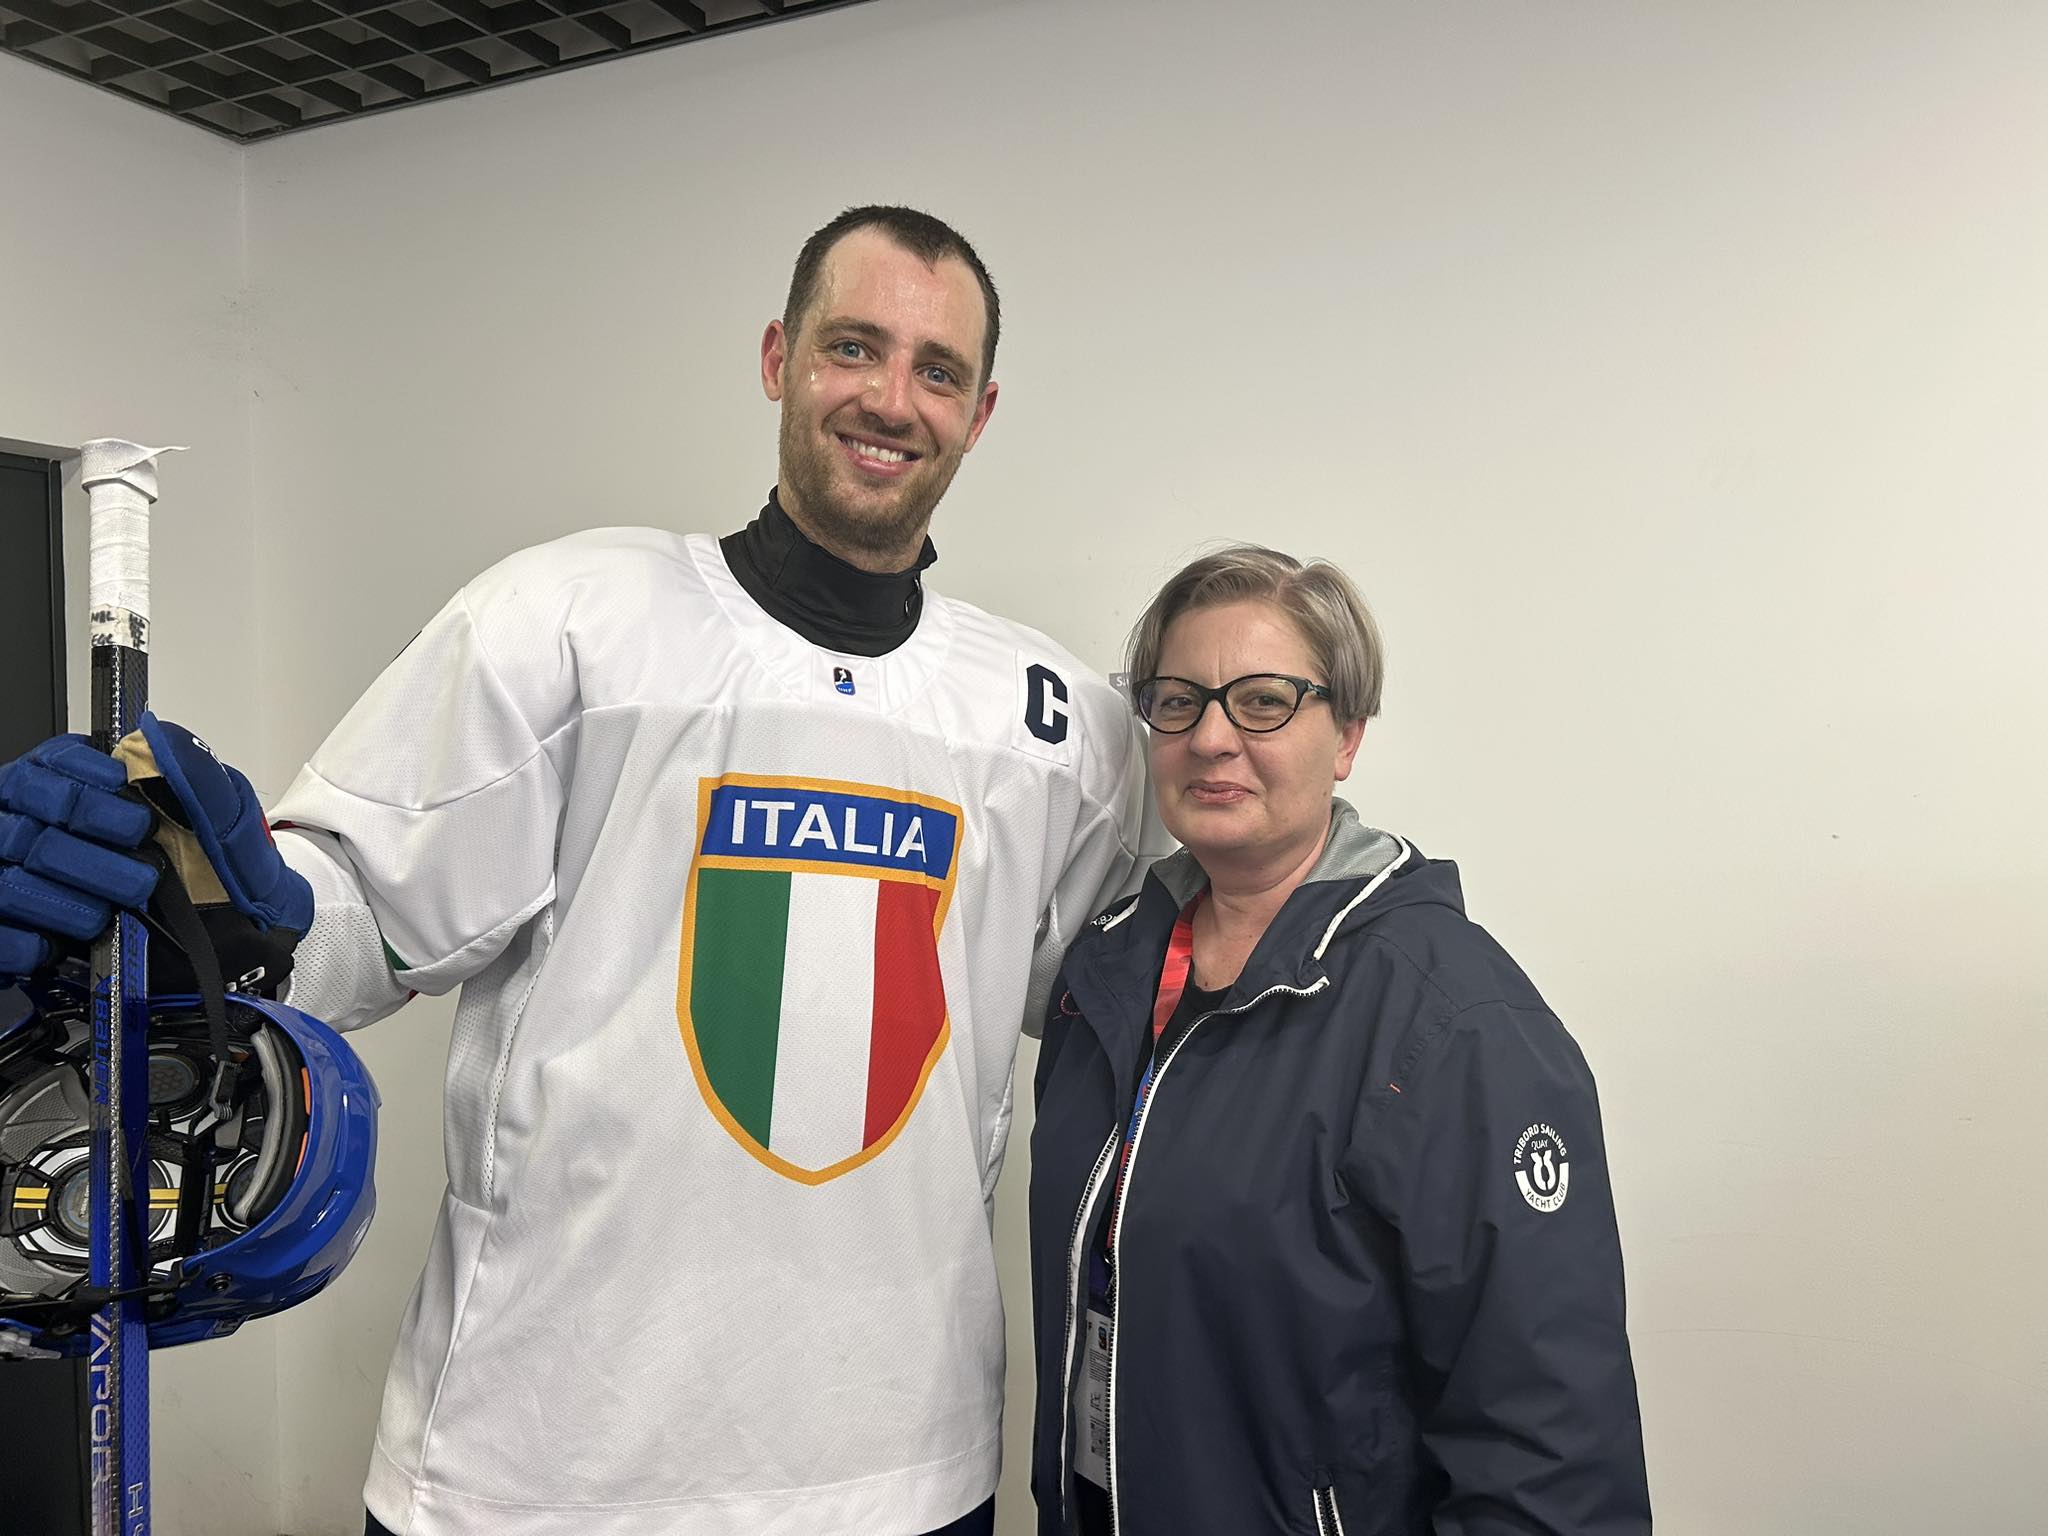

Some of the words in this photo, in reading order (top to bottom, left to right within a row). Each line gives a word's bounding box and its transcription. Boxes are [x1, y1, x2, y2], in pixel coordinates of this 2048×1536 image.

[1024, 663, 1068, 745] C
[731, 799, 927, 864] ITALIA
[1513, 1123, 1540, 1165] TRIBORD
[1540, 1123, 1567, 1157] SAILING
[1526, 1188, 1551, 1209] YACHT
[1553, 1181, 1566, 1206] CLUB
